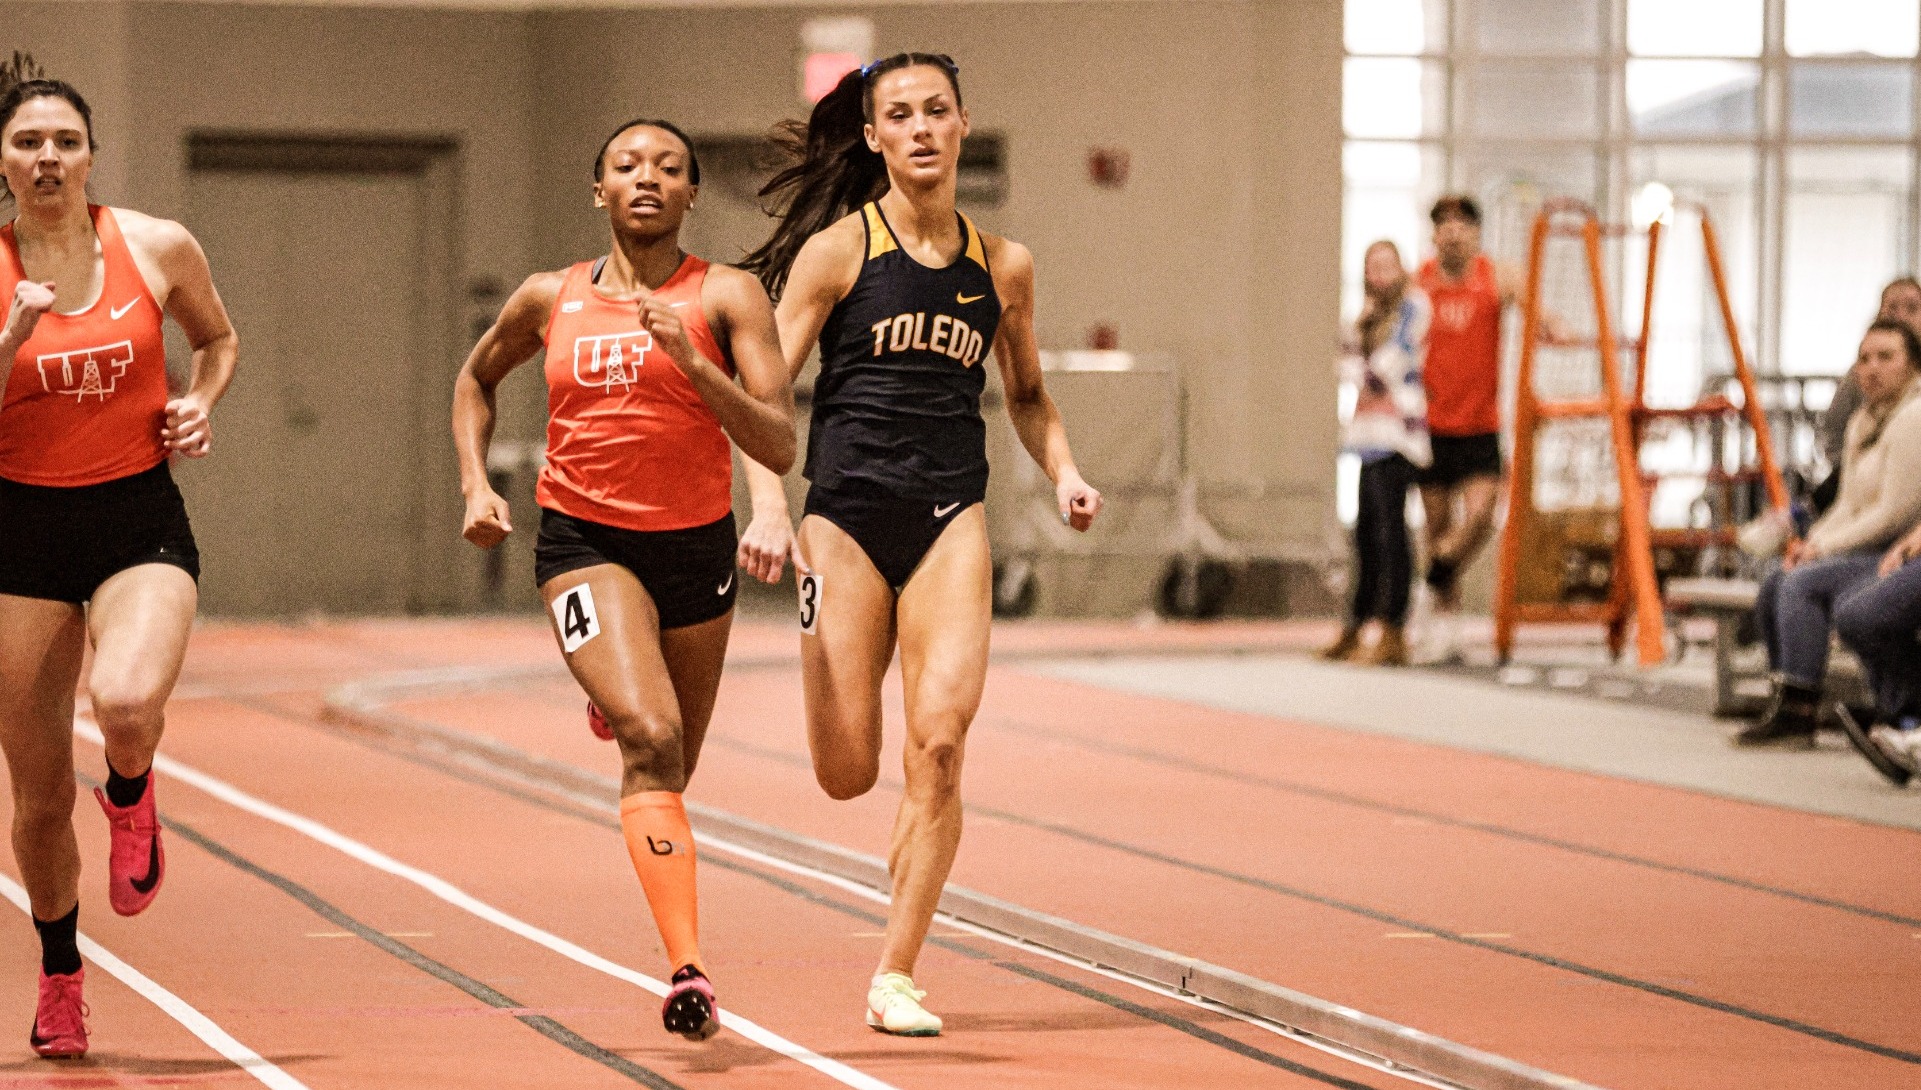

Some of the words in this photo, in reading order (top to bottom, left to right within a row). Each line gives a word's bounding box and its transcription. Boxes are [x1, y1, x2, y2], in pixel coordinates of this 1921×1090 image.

[871, 312, 983, 369] TOLEDO
[564, 591, 591, 640] 4
[801, 576, 817, 629] 3
